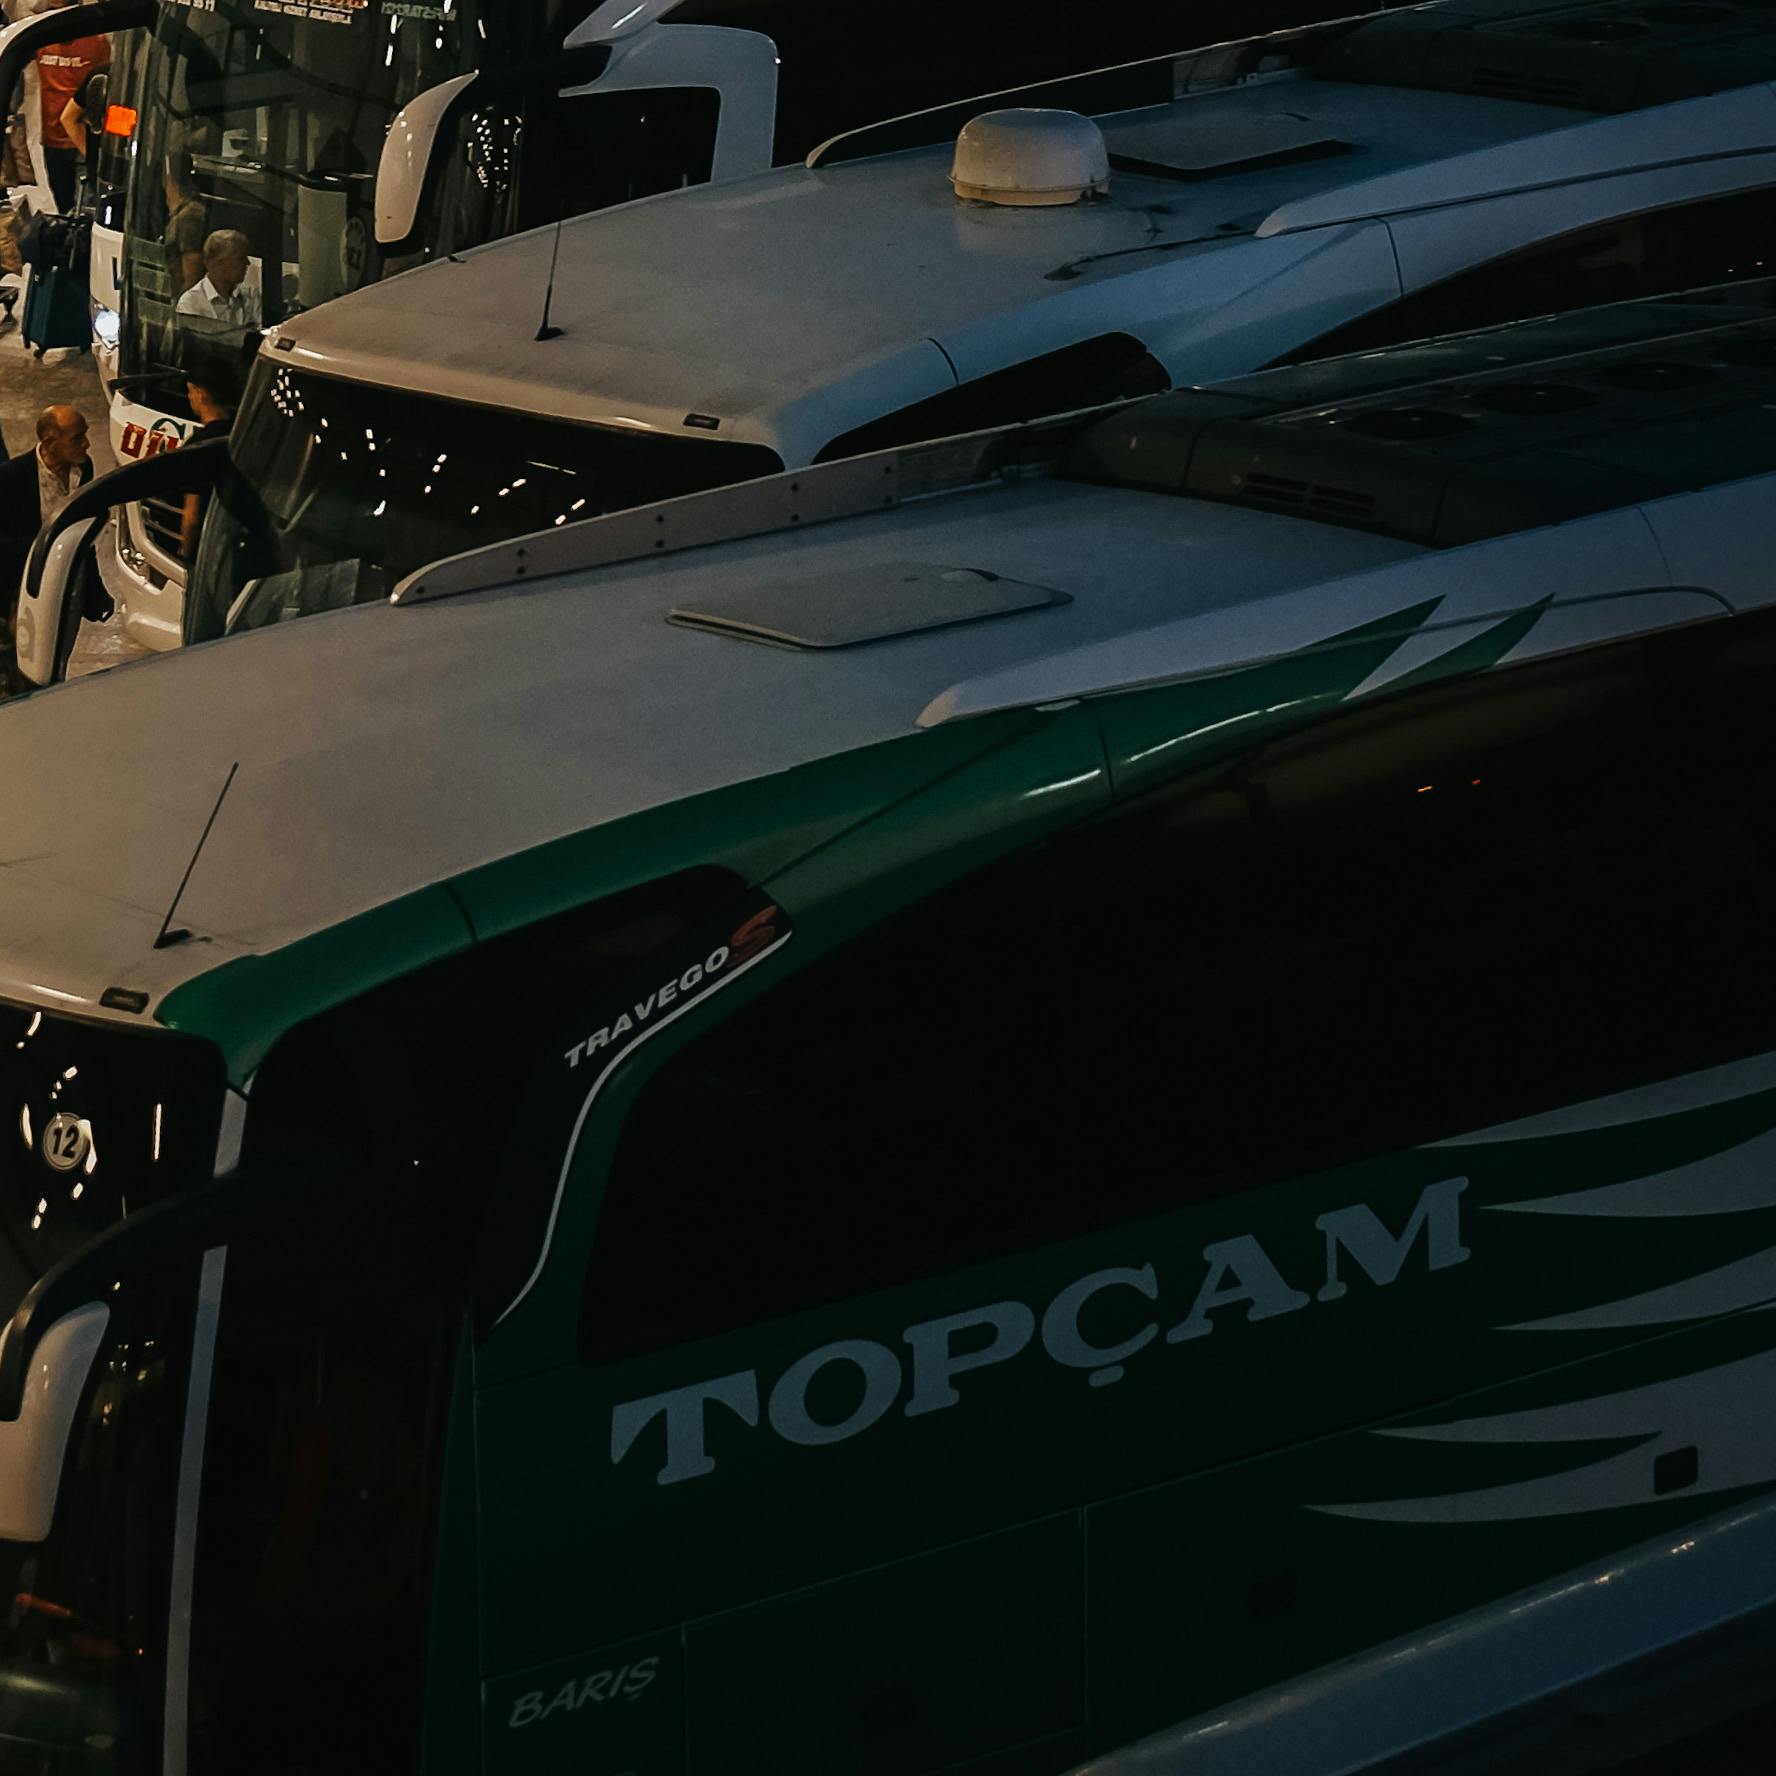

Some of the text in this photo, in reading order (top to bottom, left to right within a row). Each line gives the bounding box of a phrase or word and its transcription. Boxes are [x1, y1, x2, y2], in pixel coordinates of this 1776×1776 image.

[52, 1124, 79, 1159] 12
[609, 1175, 1472, 1486] TOPÇAM
[508, 1656, 660, 1729] BARIŞ
